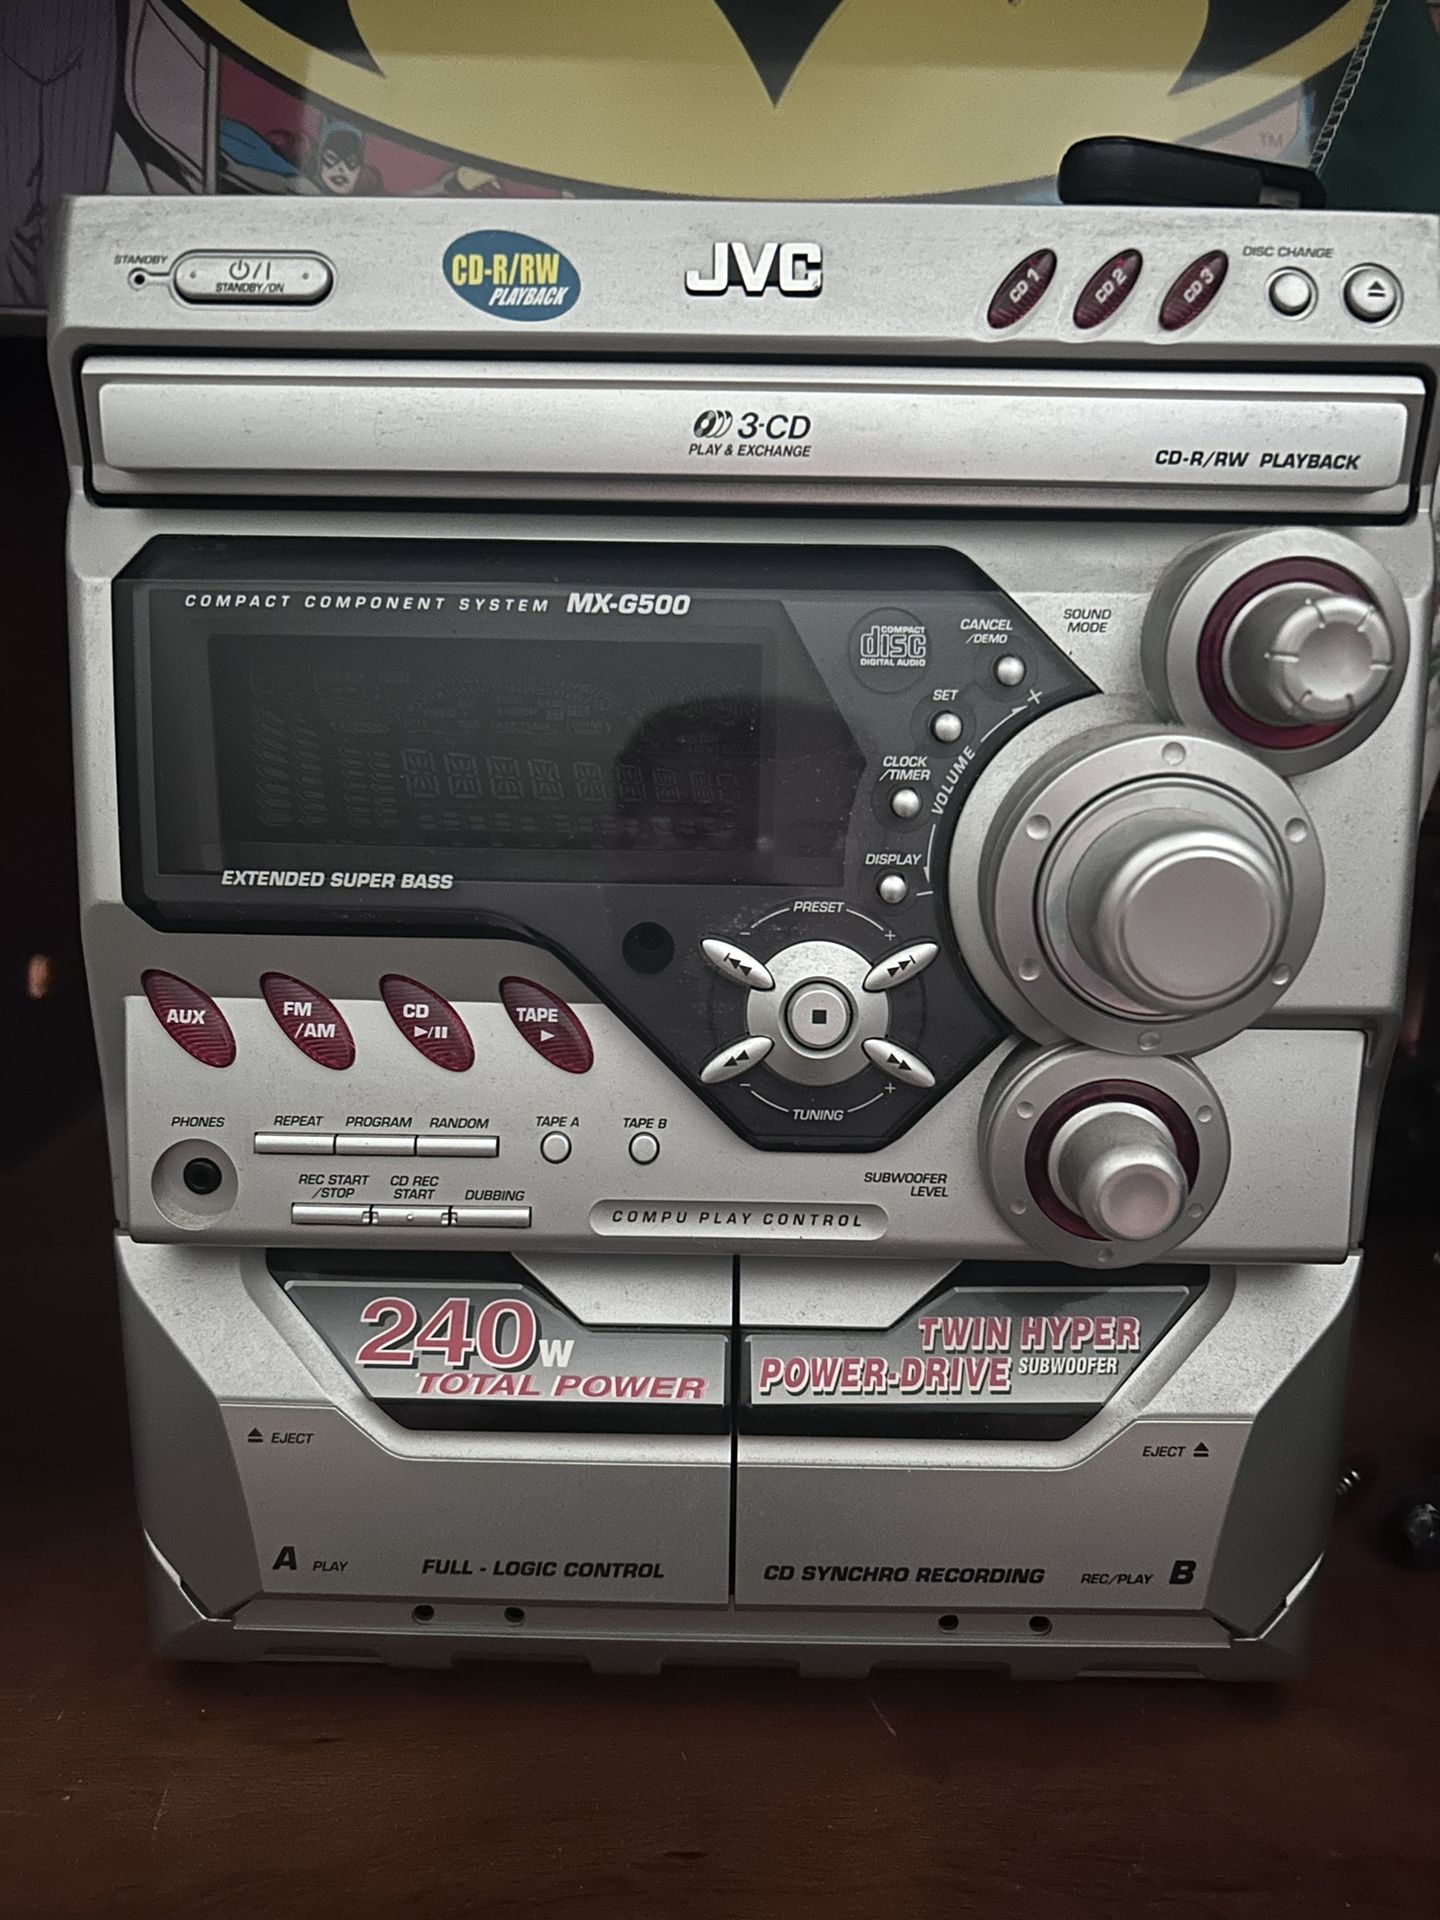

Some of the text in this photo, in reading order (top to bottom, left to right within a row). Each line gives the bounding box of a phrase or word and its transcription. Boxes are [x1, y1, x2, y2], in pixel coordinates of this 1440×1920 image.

[1260, 133, 1283, 148] TM
[1242, 246, 1334, 259] DISC CHANGE
[113, 254, 168, 266] STANDBY
[451, 253, 560, 286] CD-R/RW
[685, 242, 823, 297] JVC
[215, 282, 284, 294] STANDBY/ON
[1009, 268, 1041, 303] CD 1
[1094, 268, 1127, 303] CD 2
[1183, 267, 1215, 303] CD 3
[488, 286, 569, 306] PLAYBACK
[688, 443, 812, 457] PLAY & EXCHANGE
[1155, 449, 1361, 470] CD-R/RW PLAYBACK
[184, 592, 691, 616] COMPACT COMPONENT SYSTEM MX-G500
[1063, 609, 1112, 620] SOUND
[881, 626, 925, 634] COMPACT
[960, 618, 1013, 631] CANCEL
[1066, 621, 1109, 633] MODE
[966, 633, 1008, 644] /DEMO
[860, 658, 926, 667] DIGITAL AUDIO
[932, 689, 959, 701] SET
[882, 756, 927, 768] CLOCK
[879, 768, 930, 781] /TIMER
[931, 745, 976, 816] VOLUME
[865, 854, 922, 866] DISPLAY
[221, 869, 454, 890] EXTENDED SUPER BASS
[793, 901, 845, 914] PRESET
[283, 1001, 313, 1018] FM
[402, 1003, 430, 1020] CD
[516, 1008, 559, 1023] TAPE
[166, 1009, 206, 1026] AUX
[294, 1022, 336, 1039] /AM
[273, 1115, 324, 1127] REPEAT
[792, 1109, 844, 1121] TUNING
[170, 1116, 226, 1128] PHONES
[345, 1116, 413, 1129] PROGRAM
[429, 1117, 490, 1129] RANDOM
[535, 1116, 580, 1128] TAPE A
[623, 1117, 667, 1129] TAPE B
[299, 1174, 370, 1186] REC START
[390, 1174, 439, 1187] CD REC
[863, 1172, 948, 1184] SUBWOOFER
[311, 1186, 355, 1199] /STOP
[393, 1188, 437, 1200] START
[465, 1189, 525, 1201] DUBBING
[910, 1186, 949, 1198] LEVEL
[612, 1210, 863, 1227] COMPU PLAY CONTROL
[918, 1315, 1142, 1352] TWIN HYPER
[1018, 1357, 1119, 1376] SUBWOOFER
[758, 1355, 1013, 1394] POWER-DRIVE
[415, 1372, 707, 1400] TOTAL POWER
[270, 1432, 315, 1445] EJECT
[1142, 1445, 1186, 1458] EJECT
[272, 1546, 298, 1571] A
[312, 1560, 349, 1572] PLAY
[422, 1558, 474, 1575] FULL
[492, 1560, 557, 1577] LOGIC
[563, 1561, 665, 1579] CONTROL
[1169, 1559, 1197, 1586] B
[764, 1565, 1046, 1584] CD SYNCHRO RECORDING
[1080, 1572, 1154, 1586] REC/PLAY
